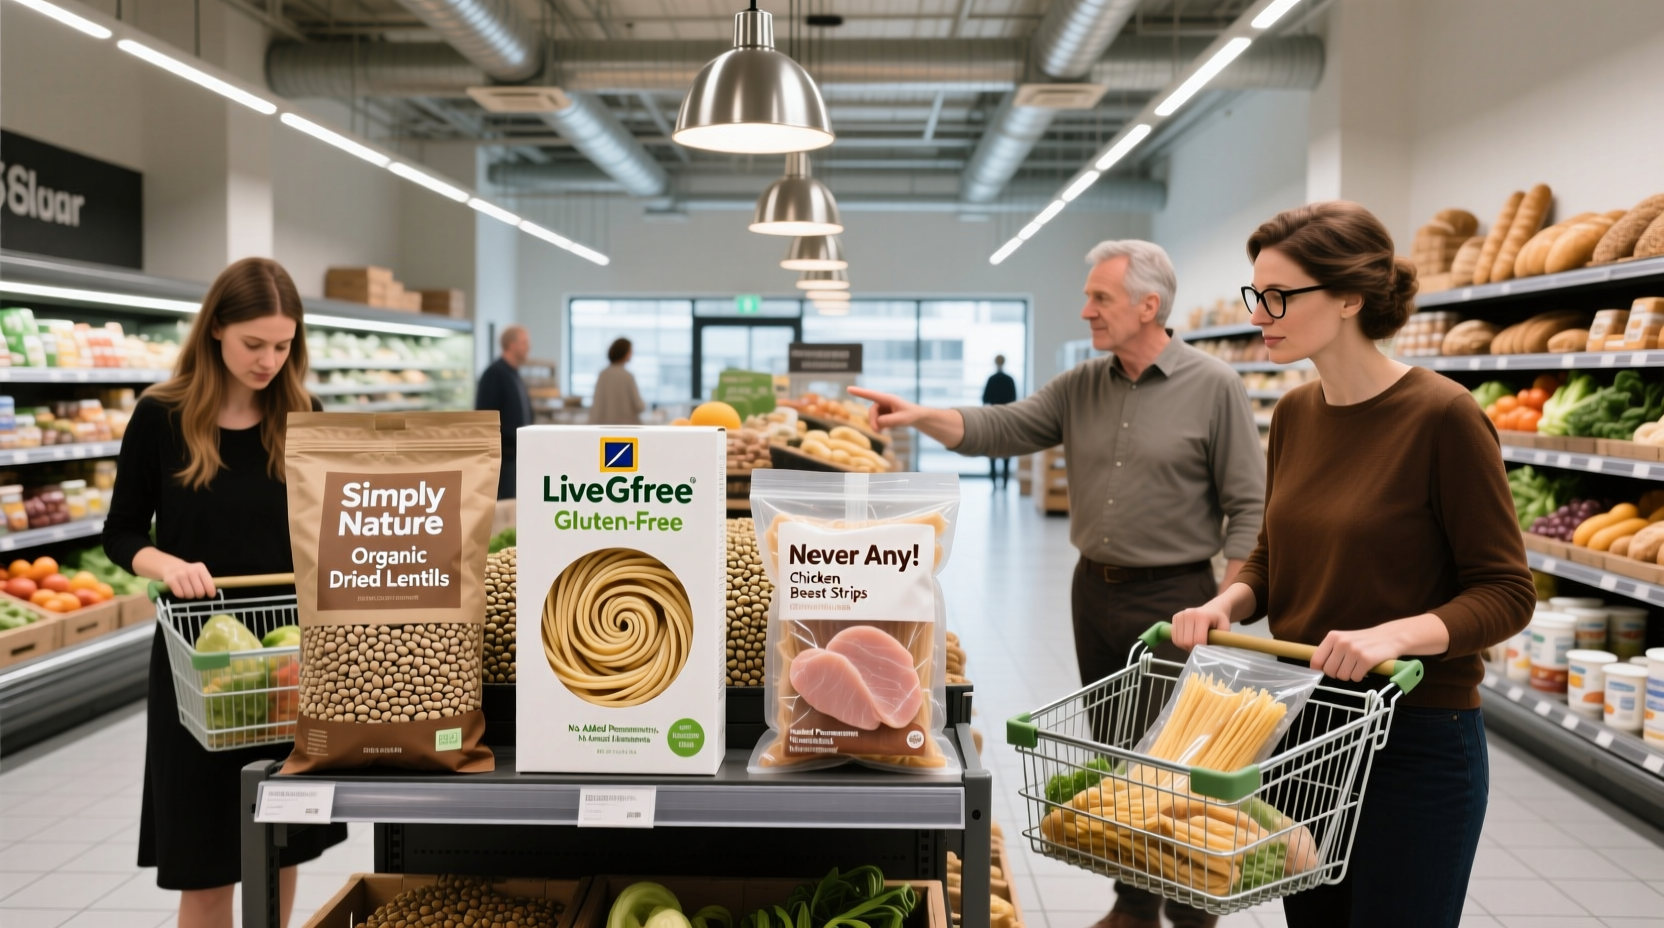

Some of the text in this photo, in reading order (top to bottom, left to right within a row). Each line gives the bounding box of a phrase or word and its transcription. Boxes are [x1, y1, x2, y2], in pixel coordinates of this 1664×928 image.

[341, 481, 446, 514] Simply
[338, 511, 443, 537] Nature
[554, 510, 683, 532] Gluten-Free
[351, 545, 427, 569] Organic
[789, 544, 919, 573] Never Any!
[329, 568, 450, 589] Dried Lentils
[790, 571, 841, 584] Chicken
[830, 585, 868, 603] Strips
